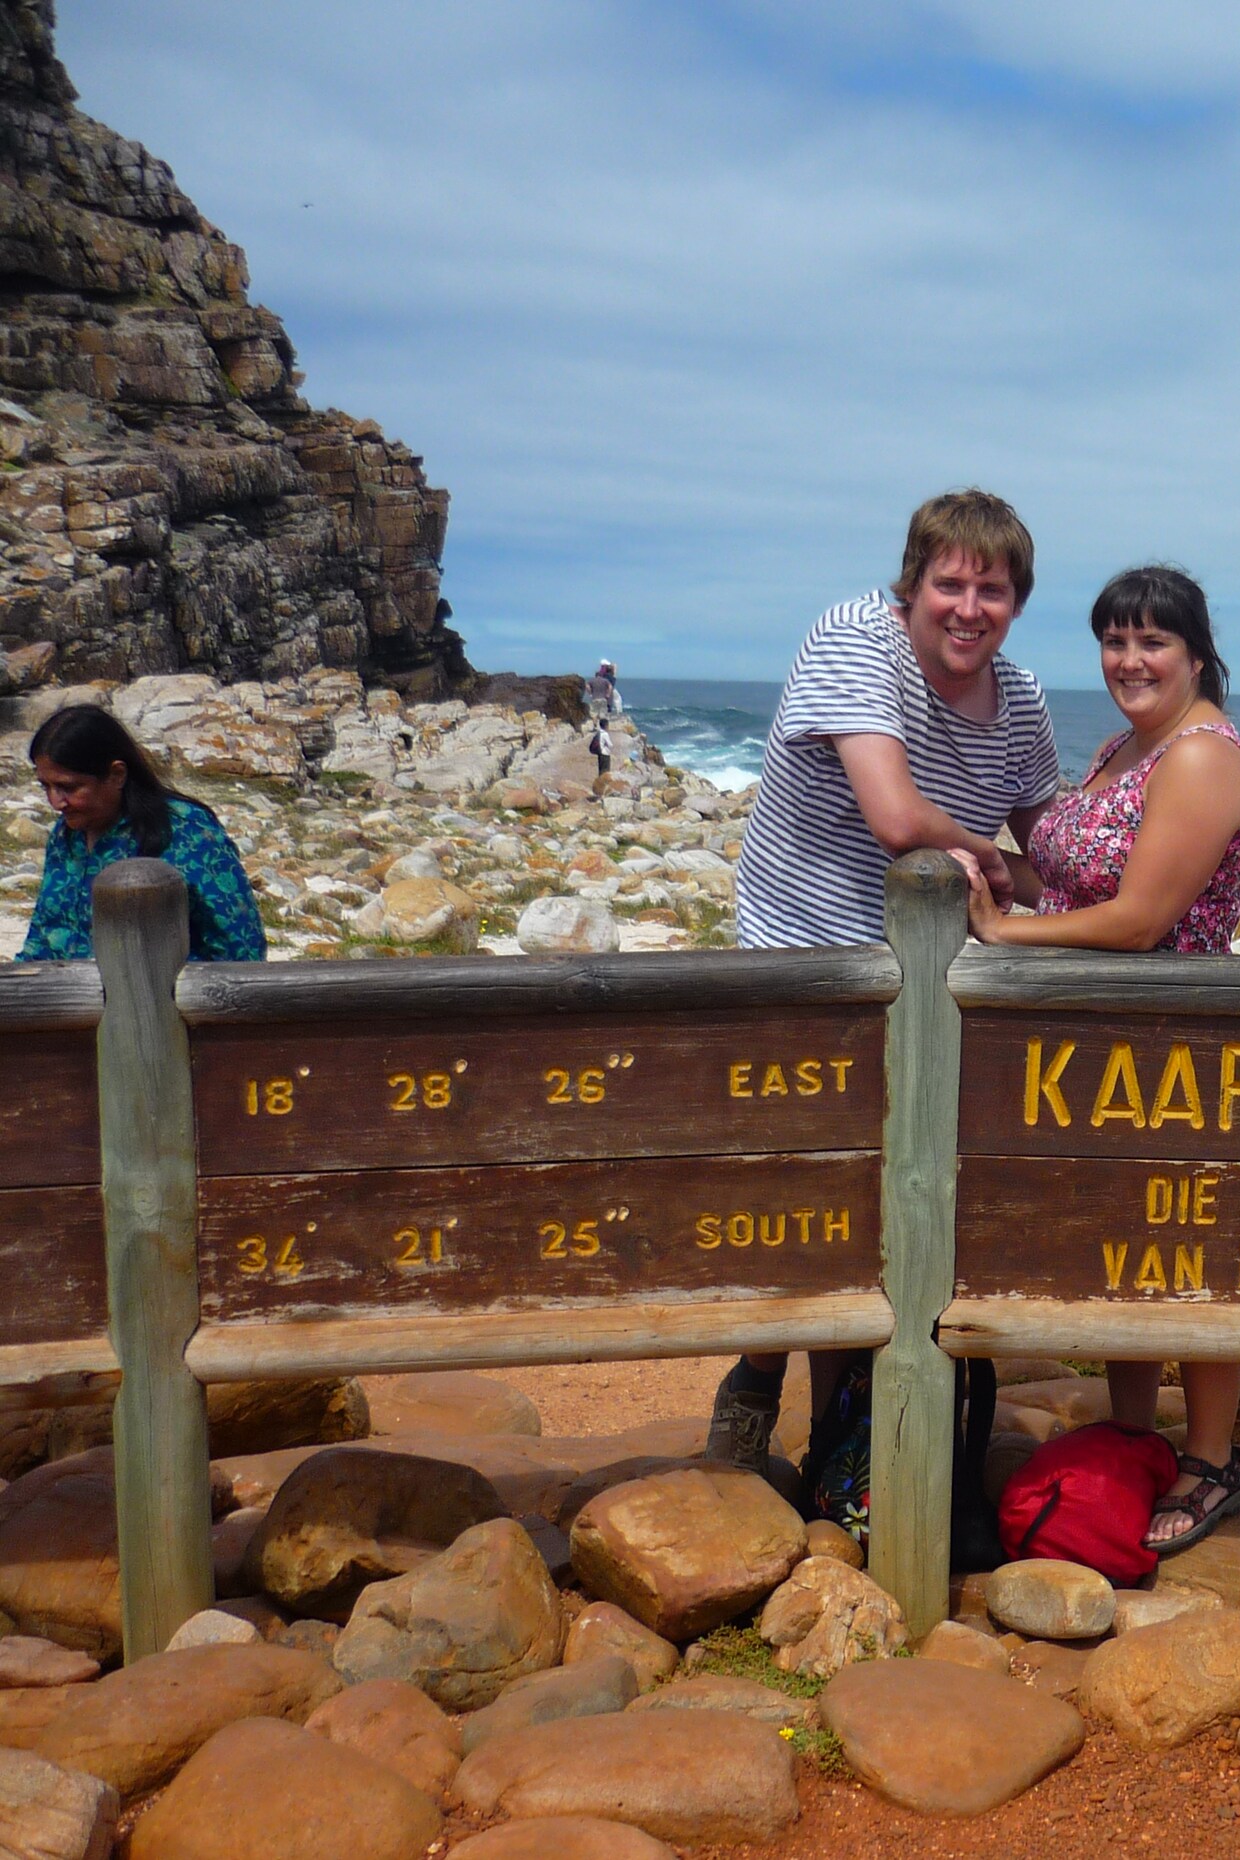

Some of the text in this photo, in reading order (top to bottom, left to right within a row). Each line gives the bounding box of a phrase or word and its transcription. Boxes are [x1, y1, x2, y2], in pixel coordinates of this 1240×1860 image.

[728, 1057, 854, 1098] EAST
[1145, 1173, 1219, 1225] DIE
[694, 1206, 851, 1250] SOUTH
[1102, 1240, 1205, 1293] VAN
